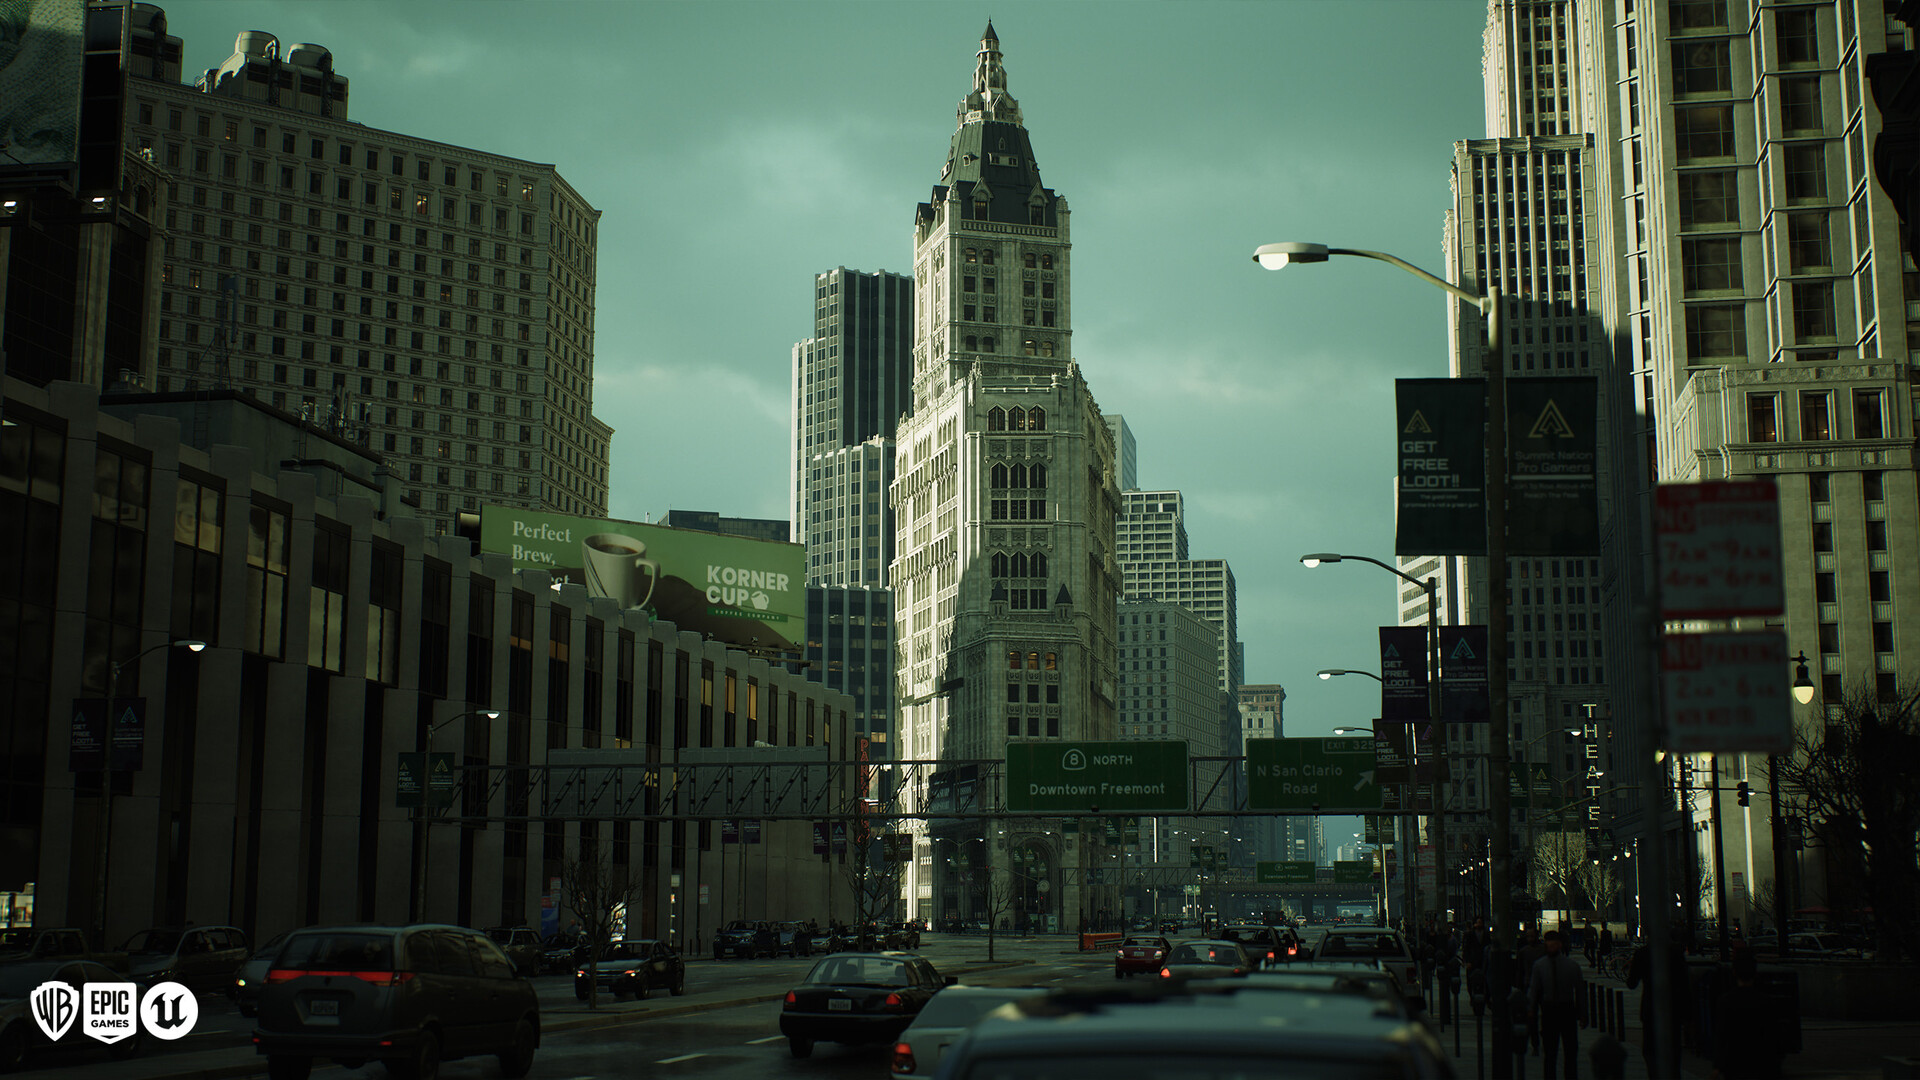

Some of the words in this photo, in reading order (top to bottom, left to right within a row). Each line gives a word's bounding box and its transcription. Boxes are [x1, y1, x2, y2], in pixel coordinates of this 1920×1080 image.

[1402, 440, 1438, 453] GET
[1514, 450, 1556, 461] Summit
[1558, 450, 1593, 461] Nation
[1402, 458, 1449, 471] FREE
[1516, 462, 1539, 473] Pro
[1541, 462, 1591, 473] Gamers
[1402, 475, 1460, 488] LOOT!!
[512, 520, 572, 543] Perfect
[512, 543, 557, 566] Brew,
[707, 565, 789, 592] KORNER
[706, 585, 749, 607] CUP
[1384, 660, 1403, 668] GET
[1384, 669, 1409, 678] FREE
[1327, 741, 1346, 750] EXIT
[1352, 740, 1375, 750] 325
[1069, 753, 1079, 765] 8
[1093, 755, 1133, 766] NORTH
[1257, 765, 1267, 776] N
[1272, 764, 1298, 777] San
[1302, 764, 1344, 776] Clario
[1582, 703, 1601, 830] THEATE
[1029, 783, 1096, 796] Downtown
[1101, 782, 1165, 795] Freemont
[1282, 783, 1318, 794] Road
